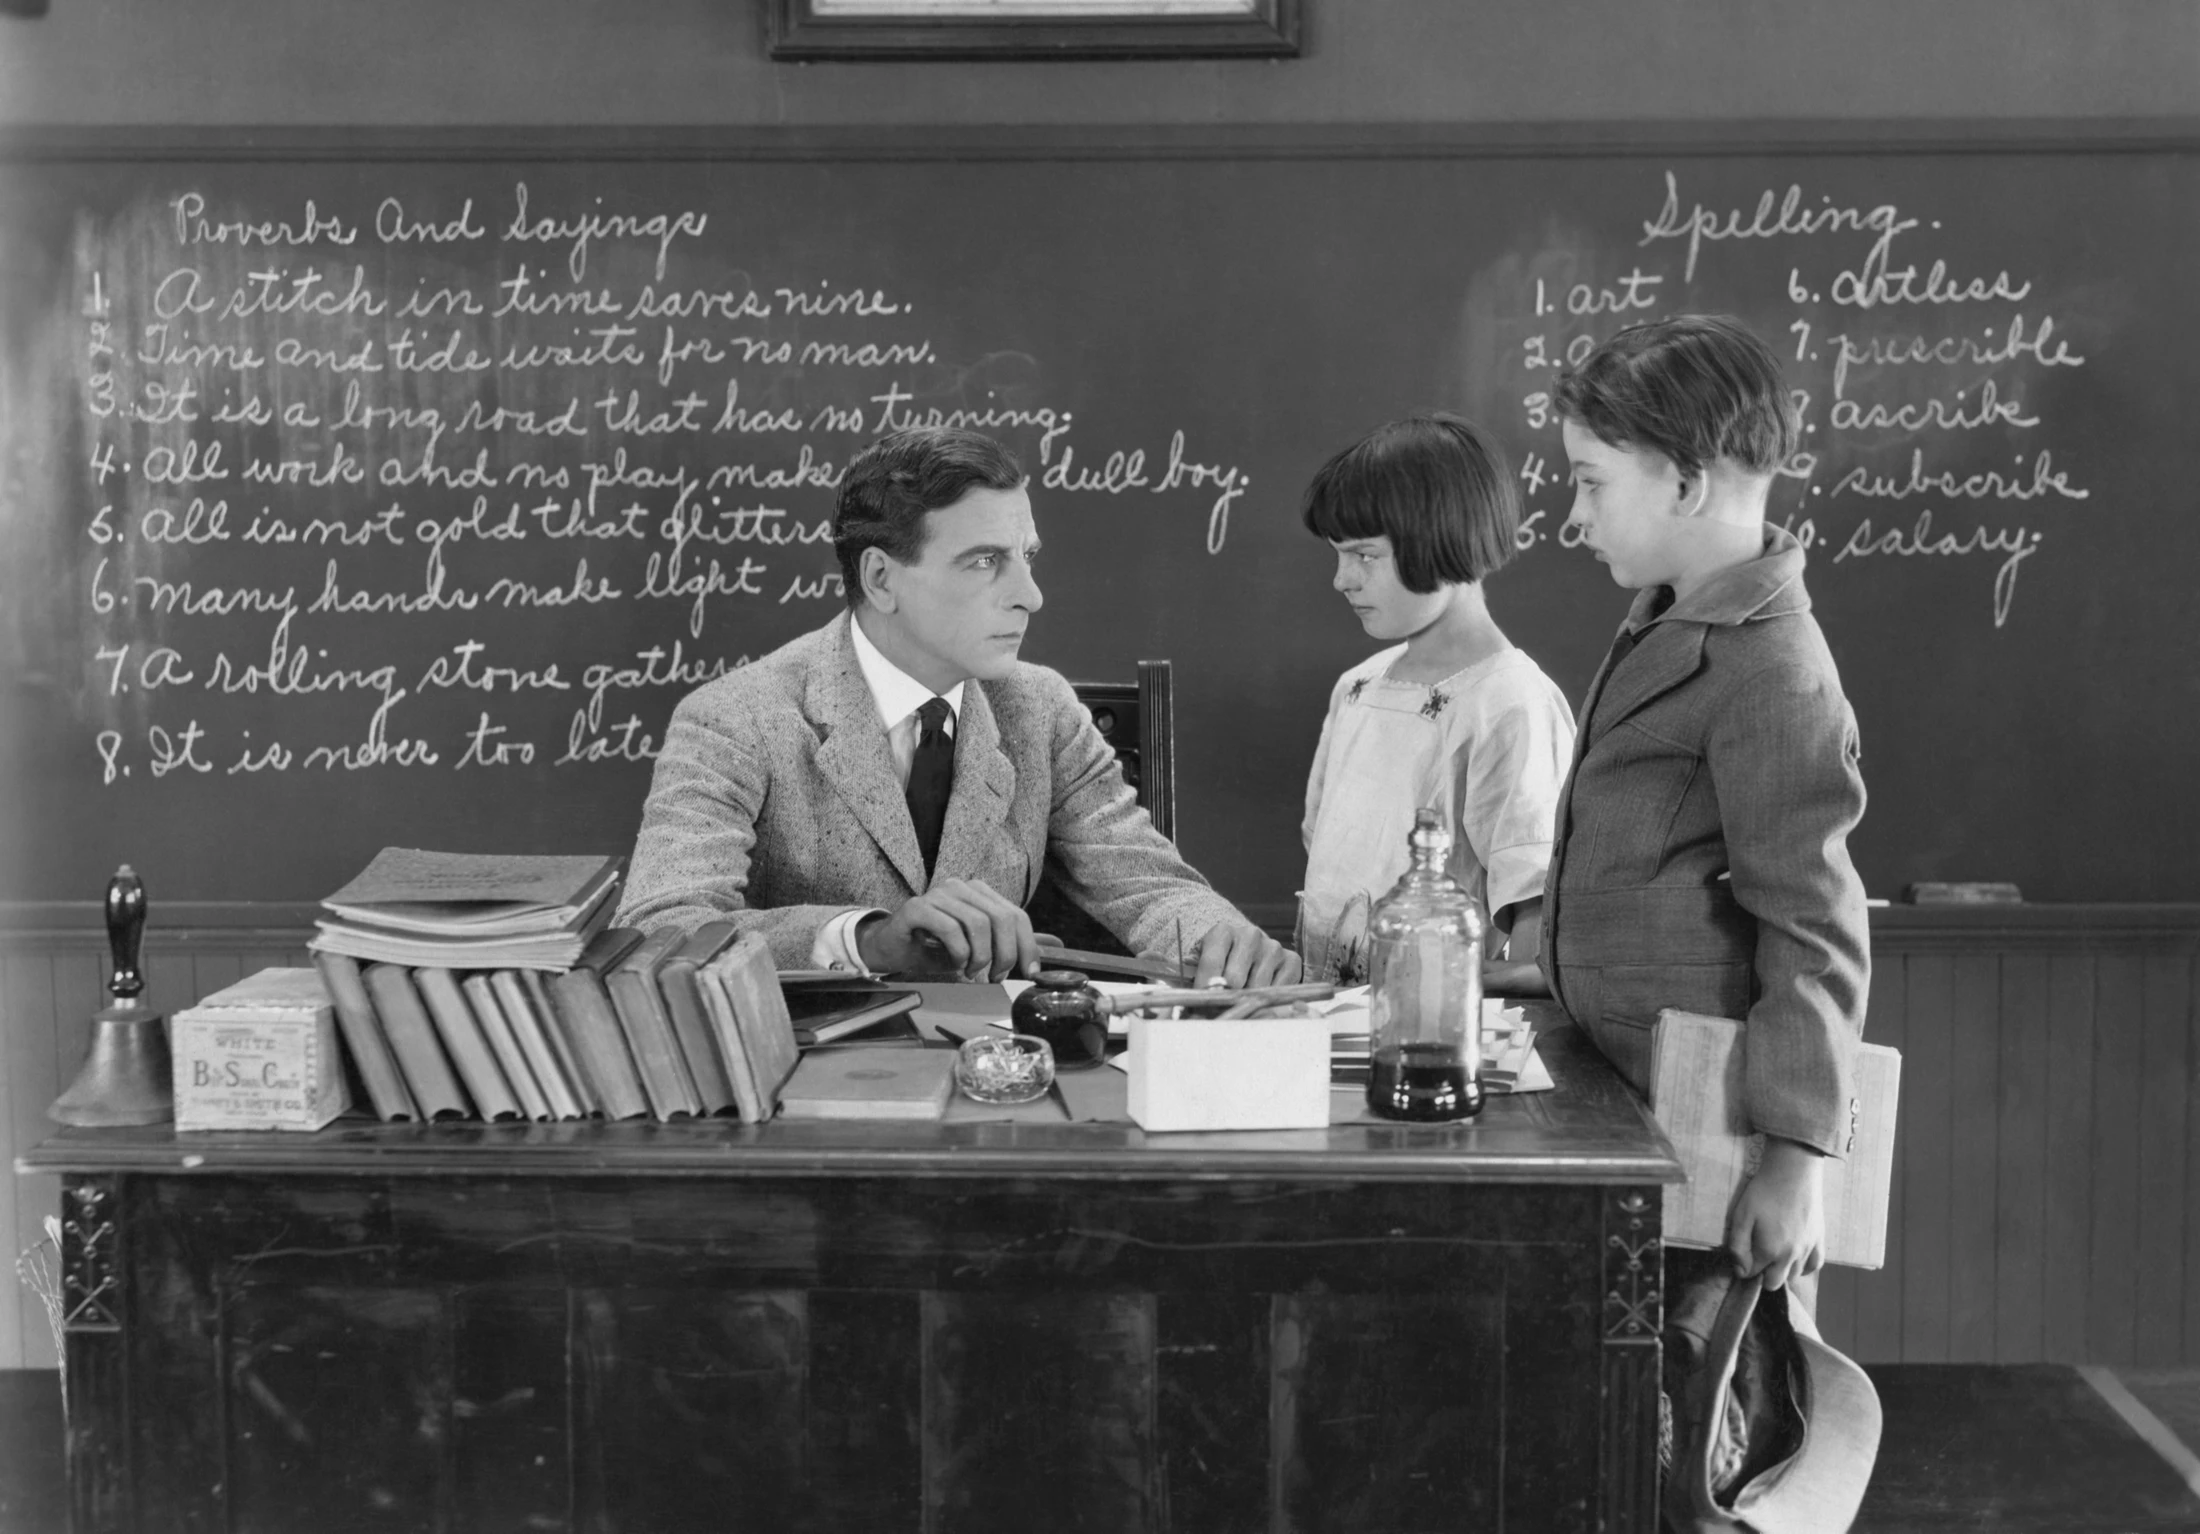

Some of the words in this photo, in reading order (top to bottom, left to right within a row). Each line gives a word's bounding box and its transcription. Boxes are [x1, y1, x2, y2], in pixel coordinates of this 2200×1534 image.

[170, 193, 357, 246] Proverbs
[376, 197, 486, 243] And
[501, 181, 708, 283] Sayings
[1638, 171, 1942, 306] Spelling.
[154, 268, 215, 319] A
[218, 264, 388, 321] stitch
[396, 278, 484, 318] in
[493, 264, 622, 318] time
[626, 286, 772, 320] saves
[775, 279, 913, 316] nine.
[1536, 278, 1555, 317] 1.
[1567, 266, 1664, 315] art
[1789, 267, 1821, 303] 6.
[1831, 259, 2032, 304] artless
[138, 322, 264, 372] Time
[387, 328, 492, 372] tide
[500, 324, 646, 370] waits
[658, 325, 726, 388] for
[730, 337, 793, 363] no
[802, 340, 937, 366] man.
[1523, 334, 1562, 370] 2.
[1790, 319, 1818, 362] 7.
[136, 376, 199, 424] It
[211, 388, 272, 426] is
[283, 402, 321, 427] a
[329, 378, 446, 480] long
[455, 400, 588, 436] road
[594, 388, 708, 434] that
[712, 378, 803, 434] has
[809, 405, 864, 433] no
[870, 381, 1073, 466] turning.
[1523, 391, 1560, 430] 3.
[1830, 379, 2041, 430] ascribe
[89, 442, 131, 485] 4.
[242, 442, 364, 486] work
[379, 448, 498, 488] and
[506, 463, 570, 488] no
[580, 447, 699, 536] play
[706, 444, 849, 490] make
[1043, 446, 1149, 493] dull
[1150, 430, 1249, 555] boy.
[1520, 451, 1560, 495] 4.
[1830, 449, 2090, 501] subscribe
[88, 505, 124, 544] 5.
[242, 506, 296, 544] is
[303, 503, 405, 545] not
[416, 495, 527, 596] gold
[531, 497, 649, 540] that
[660, 495, 840, 587] glitters
[1832, 509, 2043, 628] salary.
[91, 556, 128, 614] 6.
[309, 559, 478, 614] hands
[485, 558, 623, 607] make
[635, 552, 767, 638] light
[779, 575, 846, 604] wo
[95, 645, 129, 695] 7.
[141, 648, 193, 689] A
[205, 645, 406, 756] rolling
[417, 639, 571, 692] stone
[97, 730, 130, 784] 8.
[150, 720, 212, 776] It
[227, 729, 292, 775] is
[304, 738, 439, 770] never
[454, 712, 535, 770] too
[554, 709, 660, 766] late
